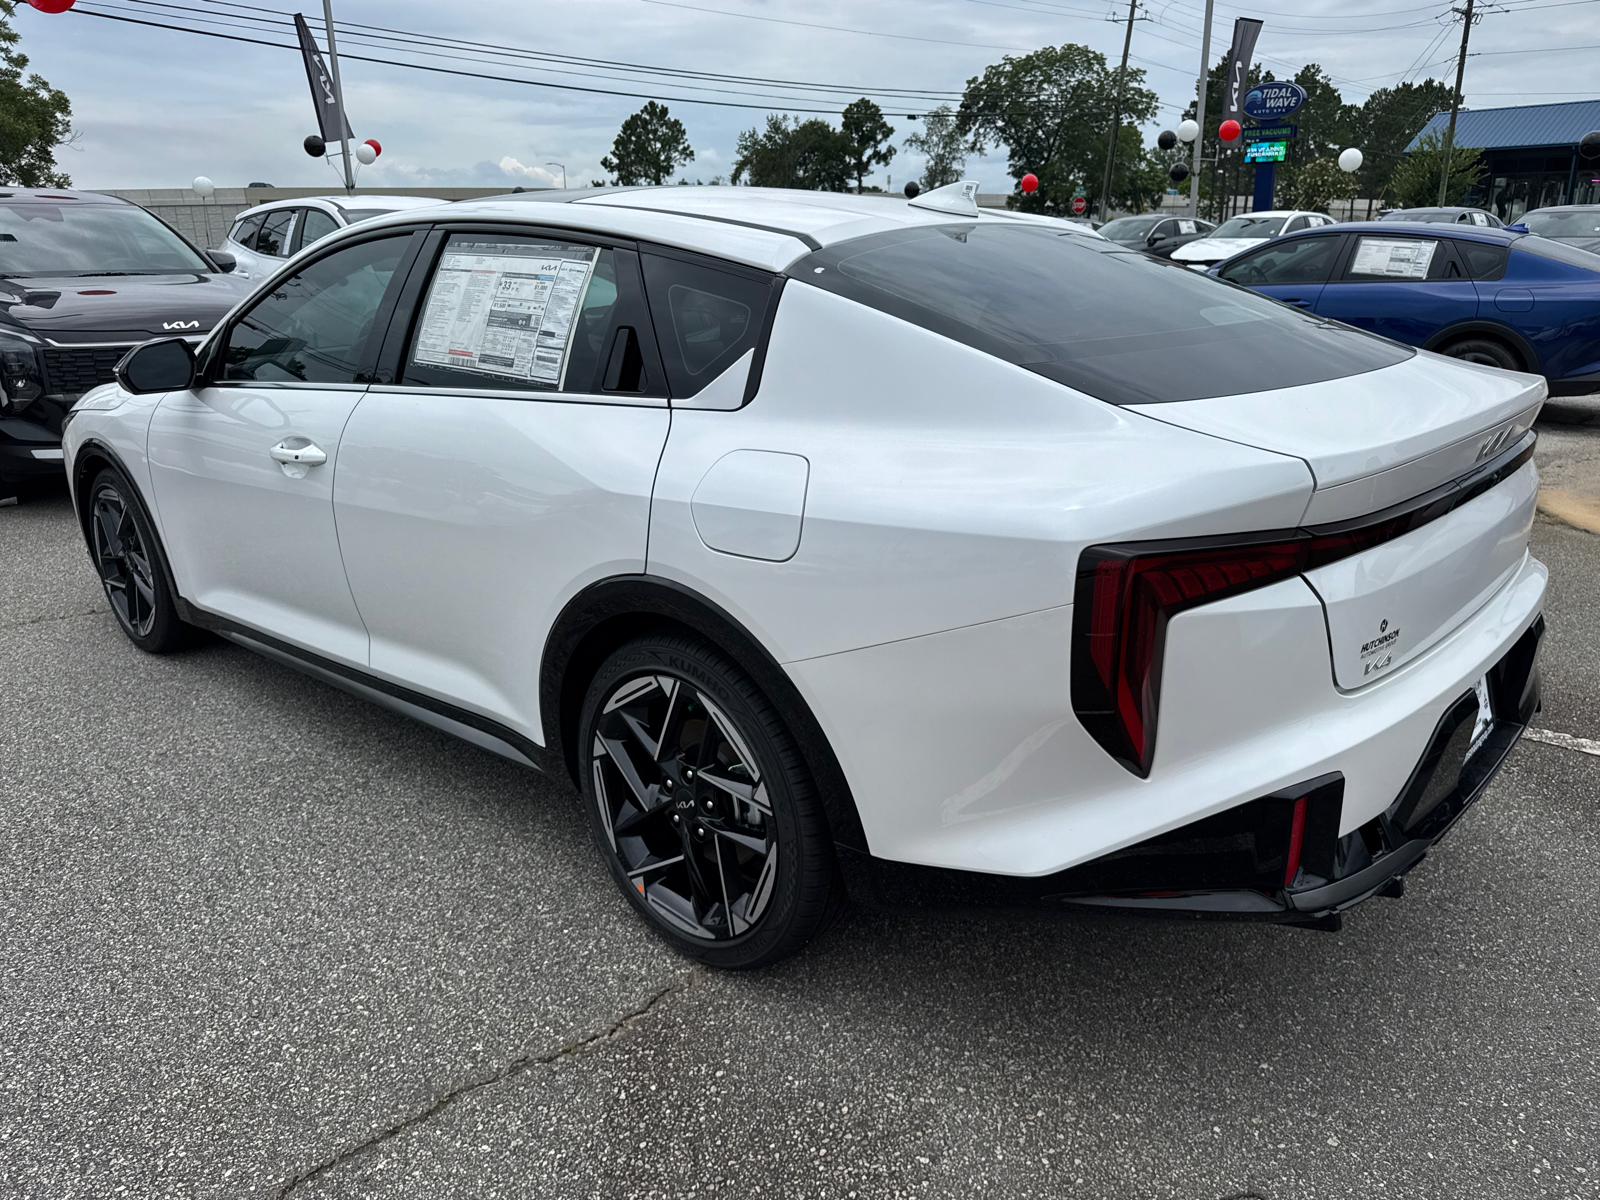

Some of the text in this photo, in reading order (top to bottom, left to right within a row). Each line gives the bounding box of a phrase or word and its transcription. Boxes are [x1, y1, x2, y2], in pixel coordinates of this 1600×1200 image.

[1262, 88, 1292, 99] TIDAL
[1266, 97, 1298, 108] WAVE
[1244, 127, 1291, 137] FREE VACUUMS
[502, 281, 512, 290] 33
[163, 320, 199, 330] KIA
[1360, 628, 1400, 653] HUTCHINSON
[669, 655, 730, 701] KUMHO
[675, 799, 695, 809] KIA
